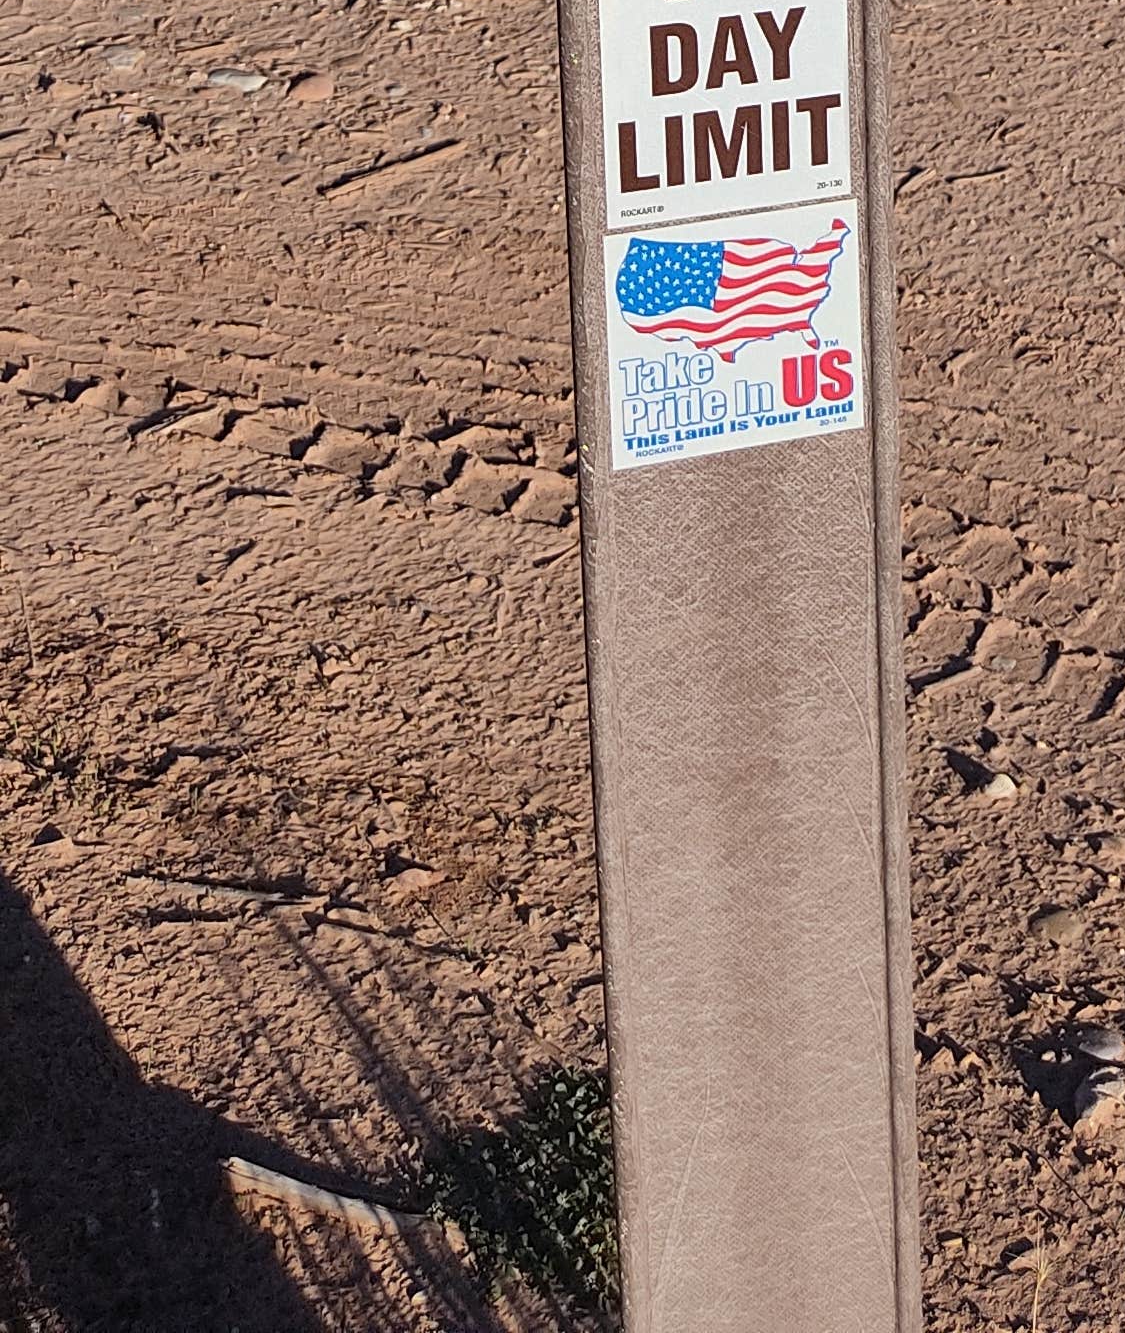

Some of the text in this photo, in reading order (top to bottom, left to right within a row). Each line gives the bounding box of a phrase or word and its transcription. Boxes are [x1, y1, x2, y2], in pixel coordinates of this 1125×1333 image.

[649, 6, 806, 96] DAY
[618, 93, 841, 193] LIMIT
[619, 352, 714, 396] Take
[622, 349, 854, 436] Pride In US
[624, 400, 854, 450] This Land Is Your Land
